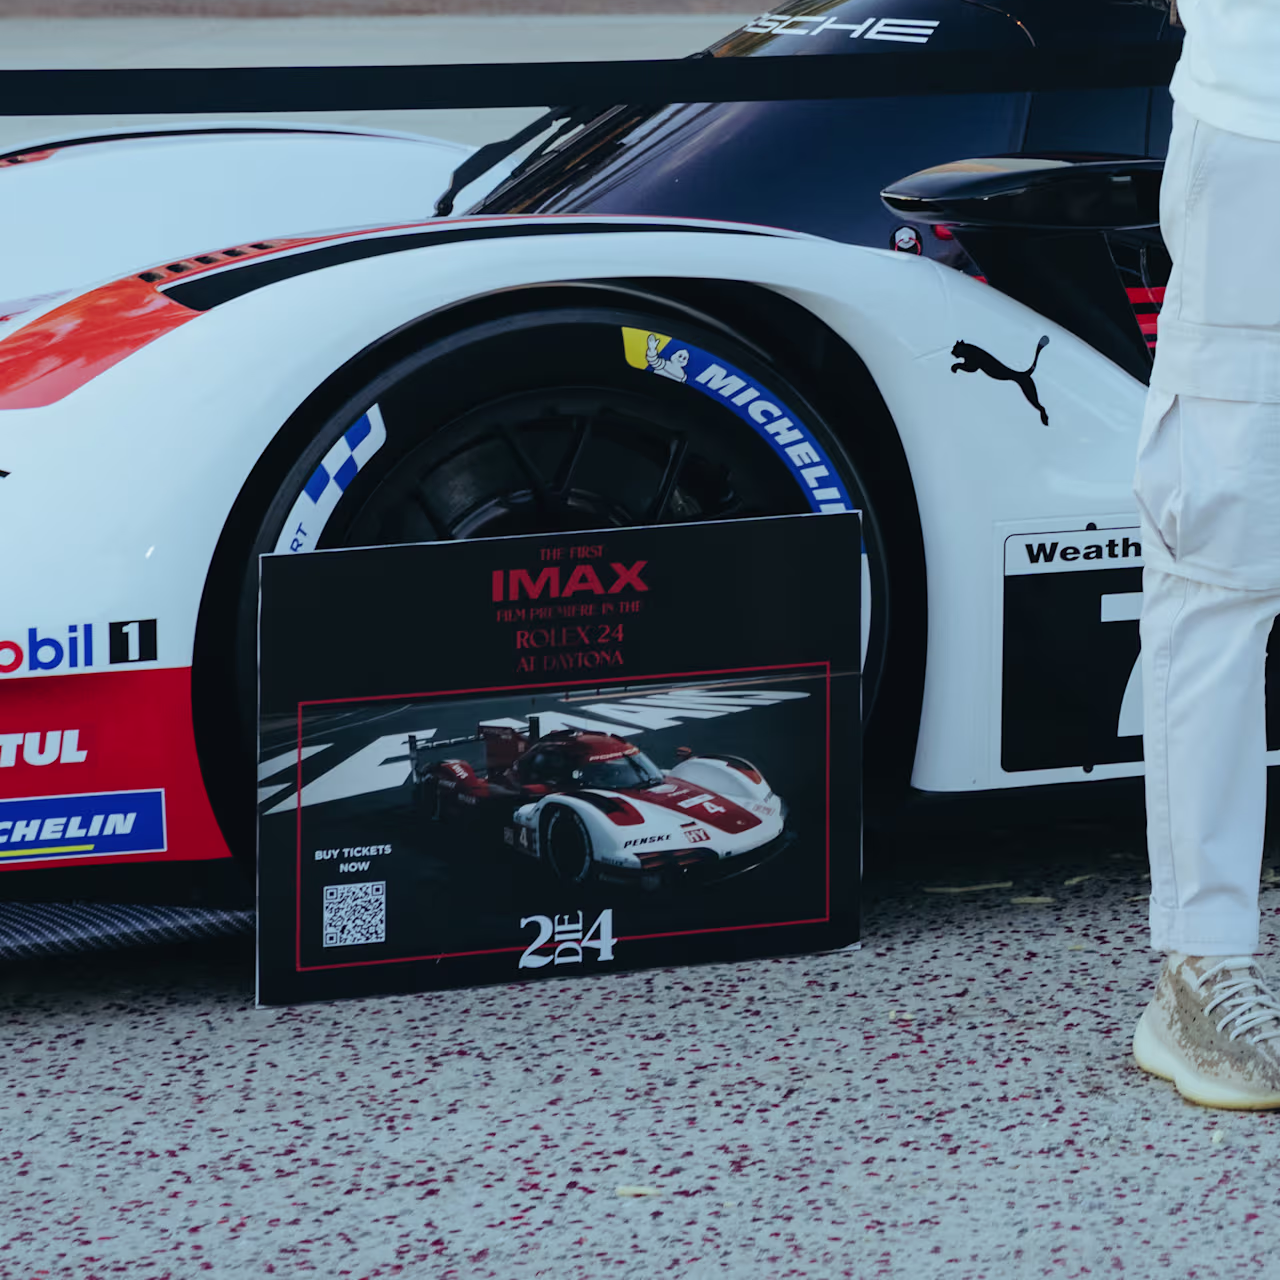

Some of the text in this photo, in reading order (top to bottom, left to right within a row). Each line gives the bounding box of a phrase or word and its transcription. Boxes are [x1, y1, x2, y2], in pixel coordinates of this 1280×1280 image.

[743, 13, 940, 44] SCHE
[694, 363, 847, 513] MICHELI
[539, 545, 605, 561] THE FIRST
[1024, 537, 1142, 564] Weath
[492, 560, 649, 602] IMAX
[497, 608, 526, 622] FILM
[601, 602, 614, 615] IN
[619, 600, 641, 613] THE
[121, 621, 141, 662] 1
[516, 624, 625, 650] ROLEX 24
[517, 650, 625, 672] AT DAYTONA
[314, 844, 392, 861] BUY TICKETS
[624, 833, 672, 849] PENSKE
[339, 861, 371, 873] NOW
